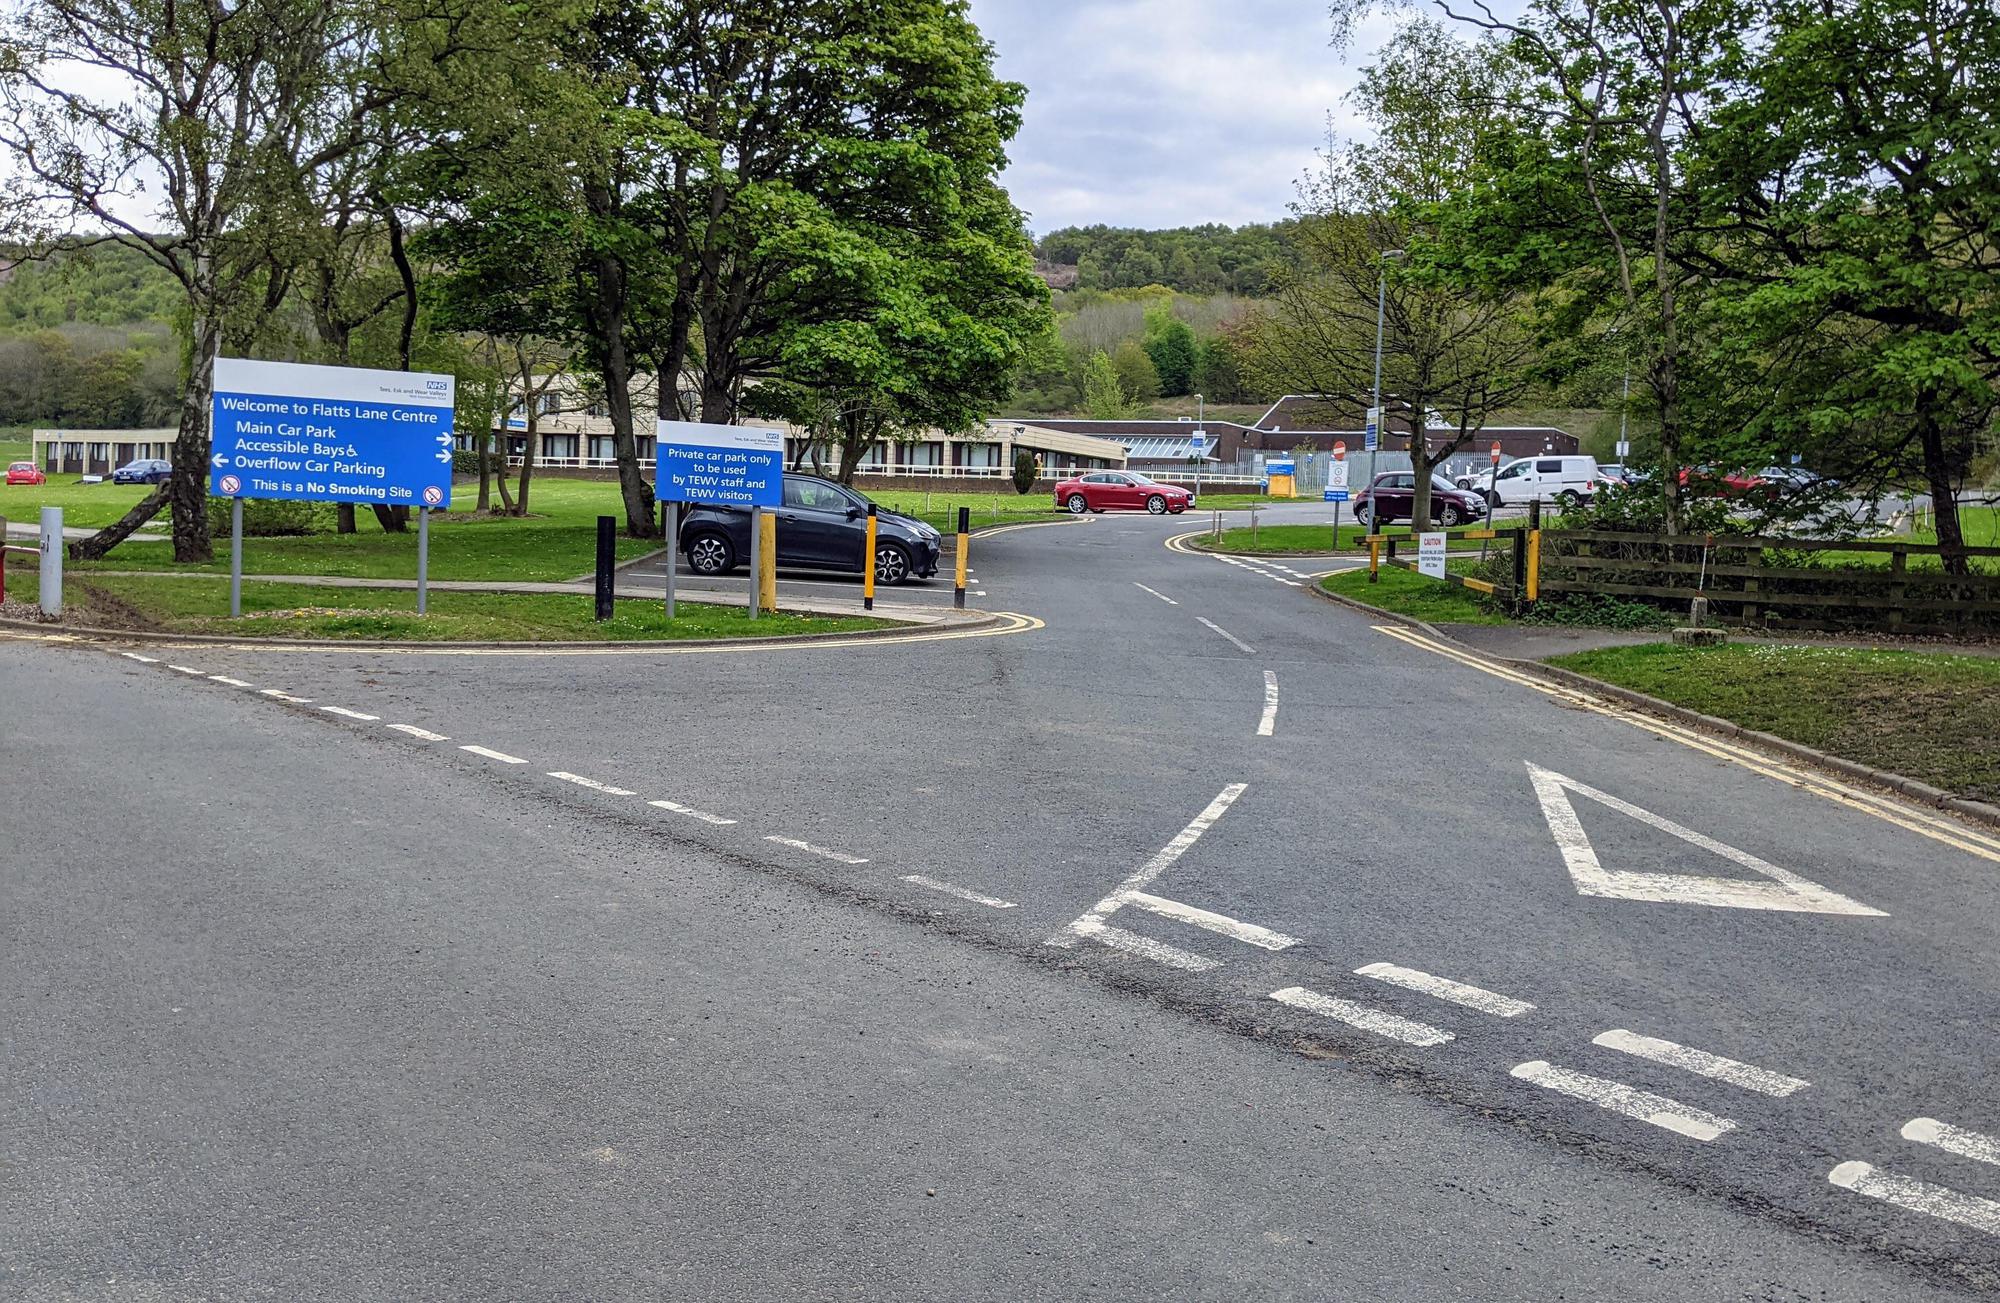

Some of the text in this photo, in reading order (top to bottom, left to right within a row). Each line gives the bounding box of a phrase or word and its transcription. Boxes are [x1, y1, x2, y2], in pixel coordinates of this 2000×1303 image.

[427, 381, 447, 390] NHS
[221, 397, 438, 424] Welcome to Flatts Lane Centre
[236, 420, 336, 439] Main Car Park
[234, 438, 345, 458] Accessible Bays
[668, 448, 772, 466] Private car park only
[234, 455, 386, 479] Overflow Car Parking
[693, 463, 747, 476] to be used
[251, 478, 413, 499] This is a No Smoking Site
[672, 473, 766, 490] by TEWV staff and
[684, 487, 753, 501] TEWV visitors
[1424, 537, 1442, 546] CAUTION
